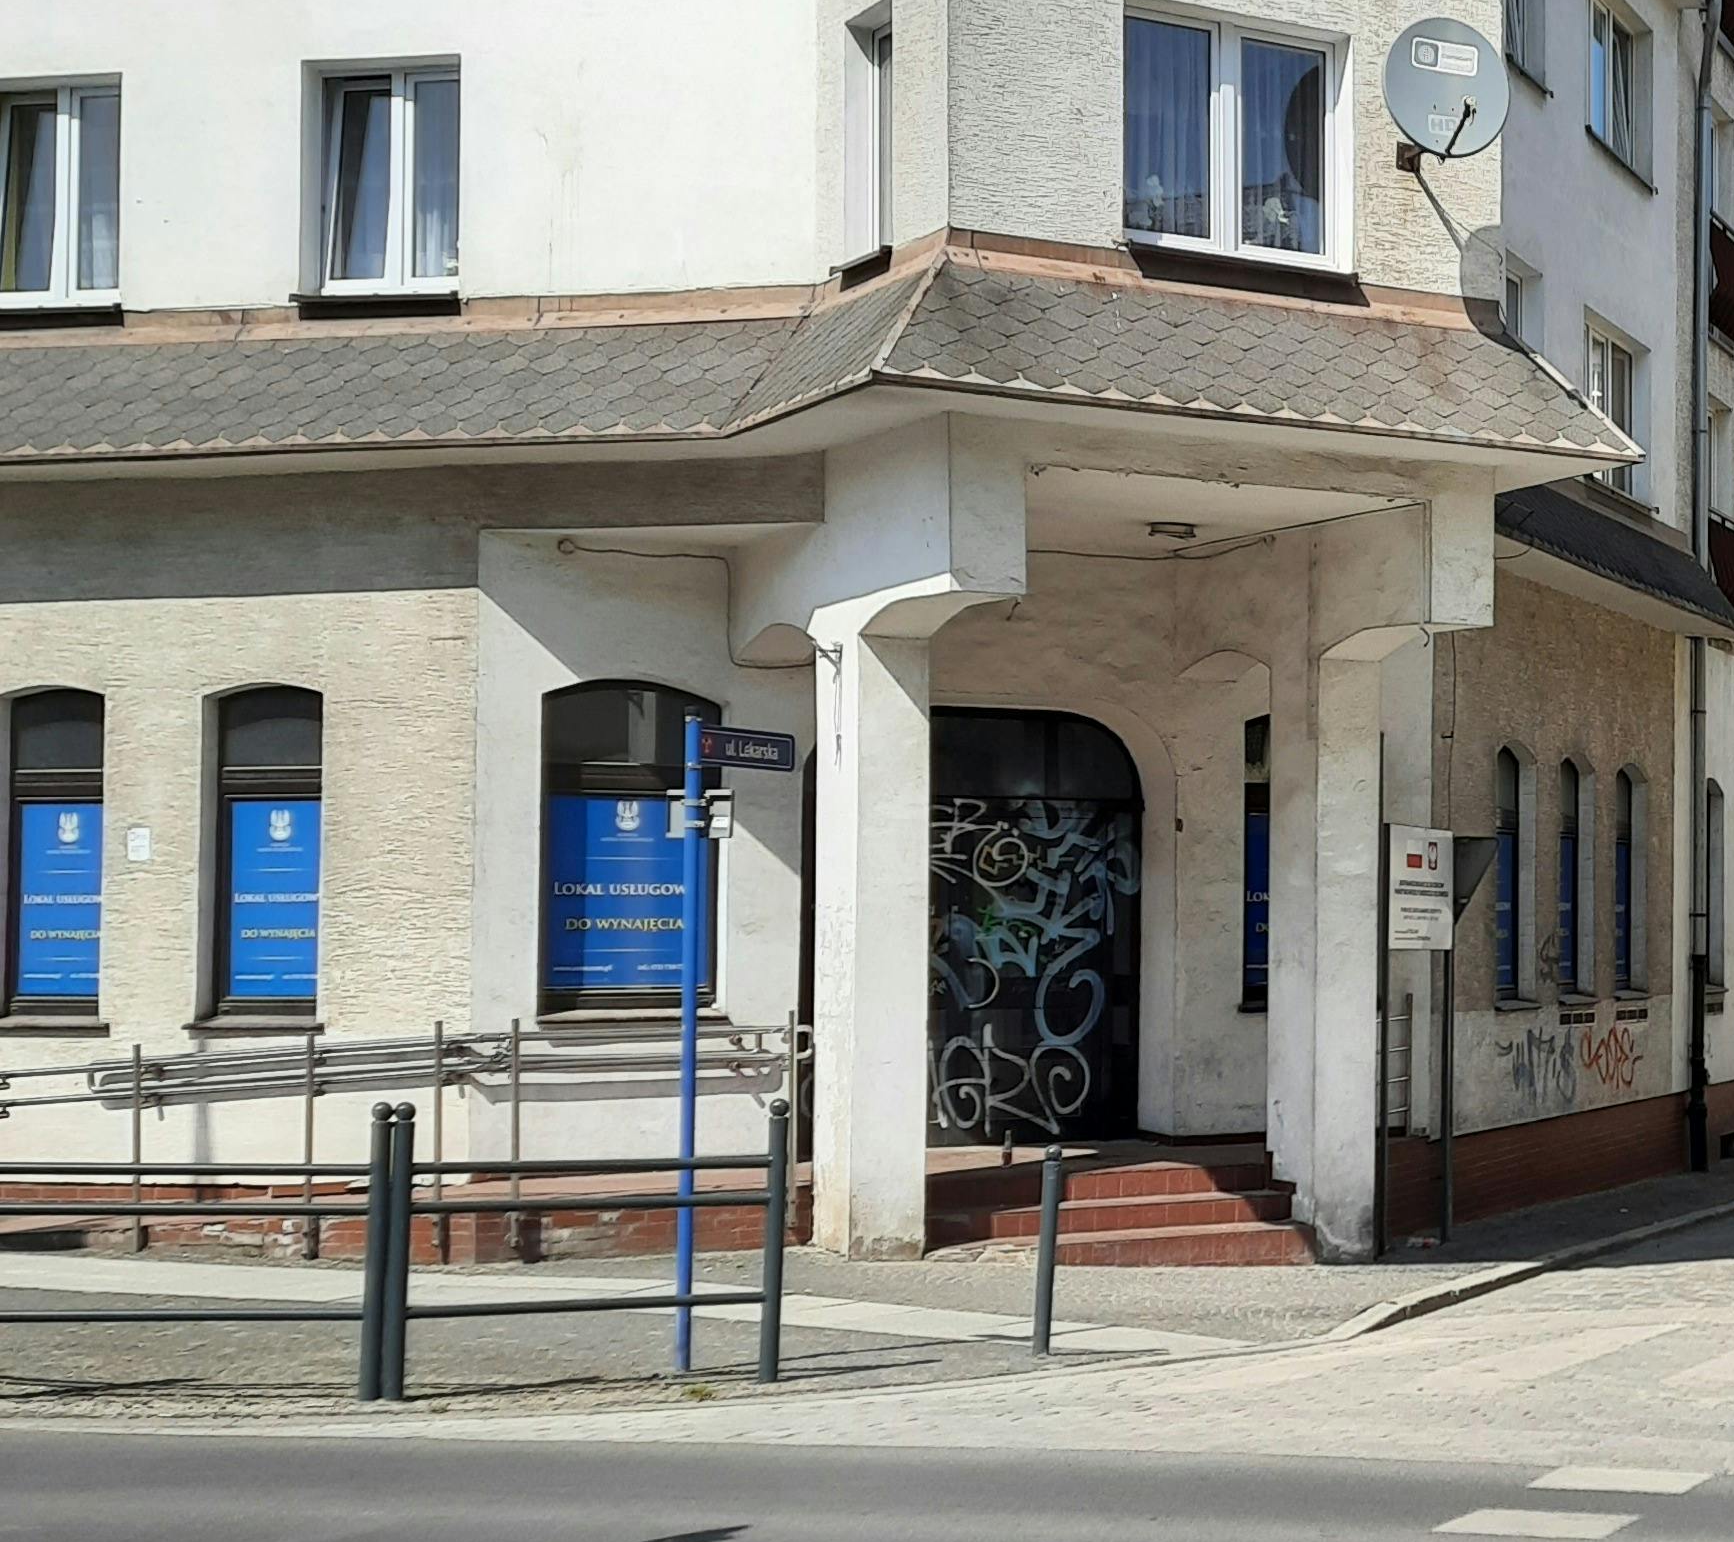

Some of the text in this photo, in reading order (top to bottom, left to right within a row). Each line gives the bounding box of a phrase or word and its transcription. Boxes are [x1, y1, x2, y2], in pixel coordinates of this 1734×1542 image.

[739, 740, 779, 761] Lekarska
[554, 881, 604, 896] LOKAL
[565, 917, 685, 933] DO WYNAJĘCIA
